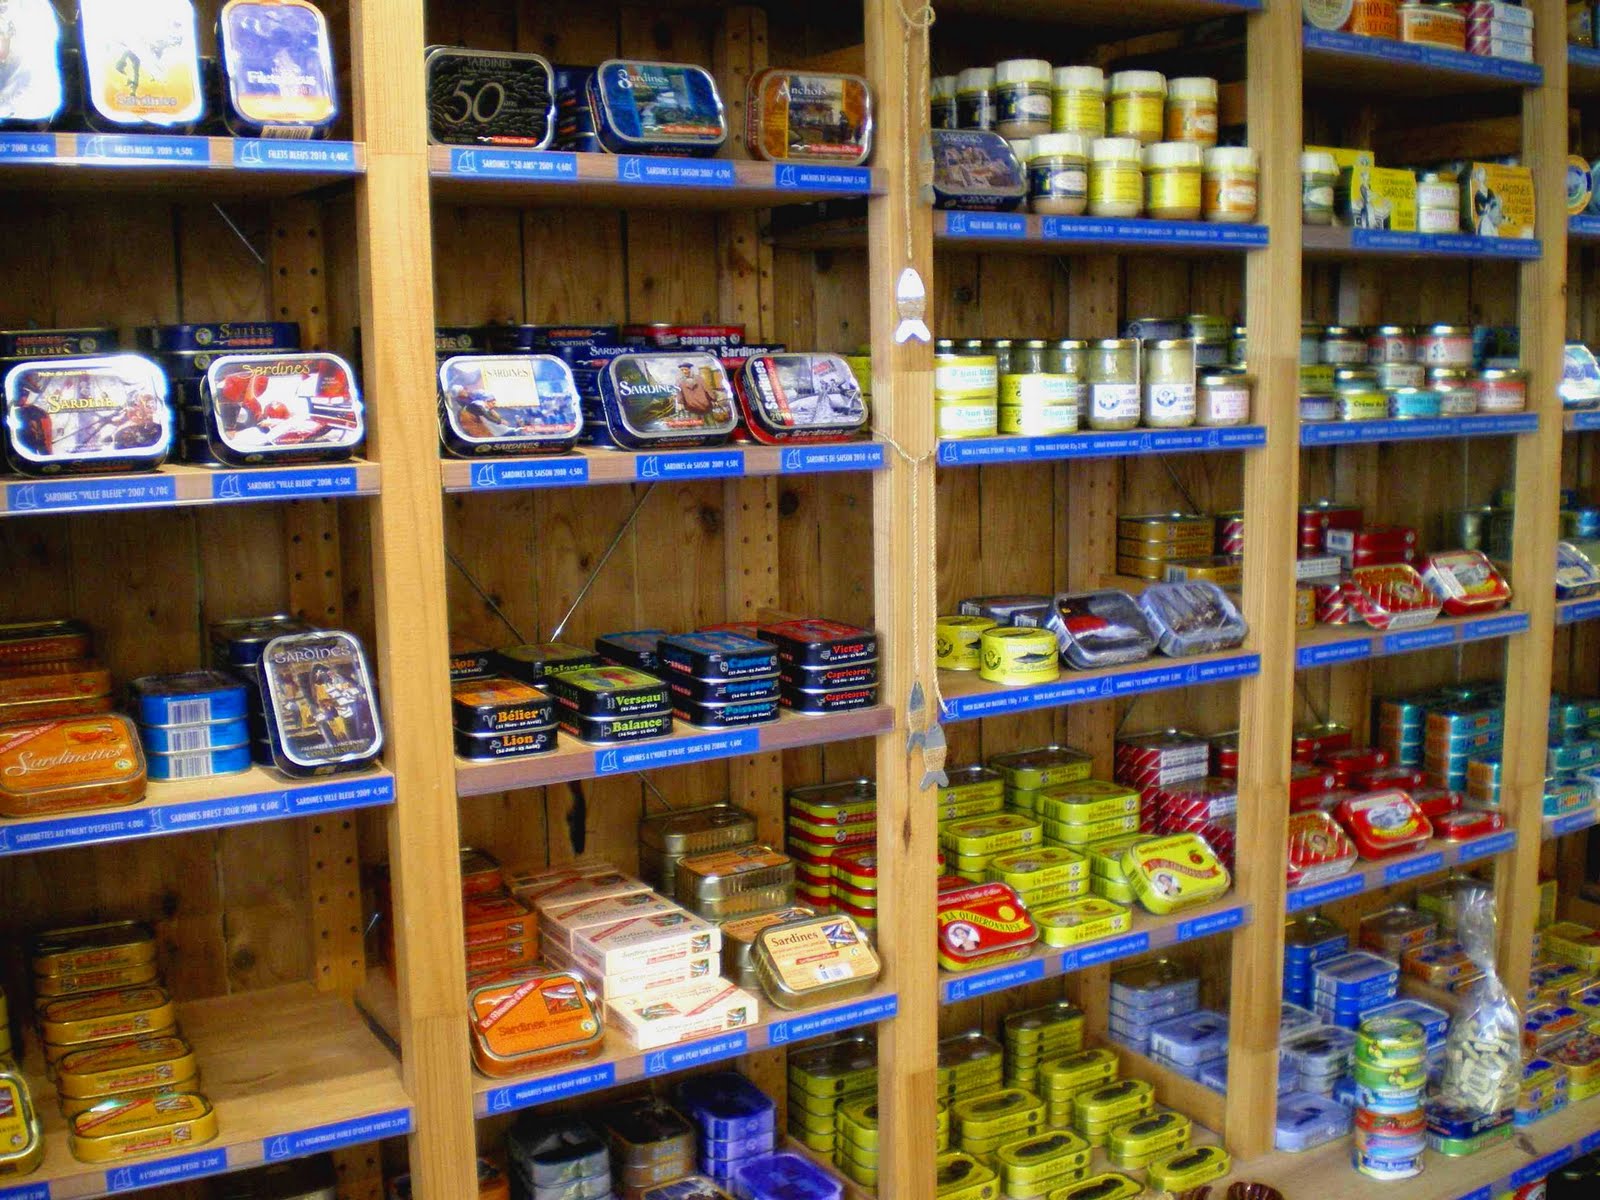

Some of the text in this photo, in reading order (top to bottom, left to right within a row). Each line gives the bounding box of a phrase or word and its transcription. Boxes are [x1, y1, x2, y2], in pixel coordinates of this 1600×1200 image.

[618, 69, 670, 90] Sardines
[776, 79, 829, 105] Anchois
[442, 80, 505, 124] 50
[482, 160, 510, 170] SARDINES
[646, 167, 671, 177] SARDINES
[721, 345, 769, 361] Sardines
[242, 361, 311, 377] Sardines
[485, 368, 531, 382] SARDINES
[619, 378, 683, 401] SARDINES
[664, 462, 686, 471] SARDINES
[693, 461, 710, 470] SAISON
[501, 470, 527, 479] SARDINES
[534, 469, 552, 478] SAISON
[246, 480, 276, 491] SARDINES
[44, 490, 77, 503] SARDINES
[79, 490, 100, 501] "VILLE
[102, 488, 127, 499] BLEUE"
[832, 643, 865, 655] Vierge
[826, 667, 871, 680] Capricorne
[615, 693, 662, 707] Verseau
[825, 690, 871, 703] Capricorne
[497, 708, 540, 724] Bélier
[611, 718, 663, 734] Balance
[502, 735, 534, 748] Lion
[6, 746, 123, 777] Sardinettes
[622, 754, 646, 764] SARDINES
[295, 794, 323, 806] SARDINES
[324, 792, 338, 804] VILLE
[338, 790, 356, 801] BLEUE
[169, 811, 201, 824] SARDINES
[15, 828, 55, 844] SARDINETTES
[55, 827, 65, 837] AU
[65, 824, 88, 836] PIMENT
[89, 821, 125, 834] D'ESPELETTE
[944, 909, 1023, 931] LA QUIBERONNAISE
[770, 930, 819, 947] Sardines
[500, 1020, 547, 1035] Sardines
[672, 1054, 685, 1064] SANS
[686, 1051, 699, 1061] PEAU
[558, 1078, 577, 1092] D'OLIVE
